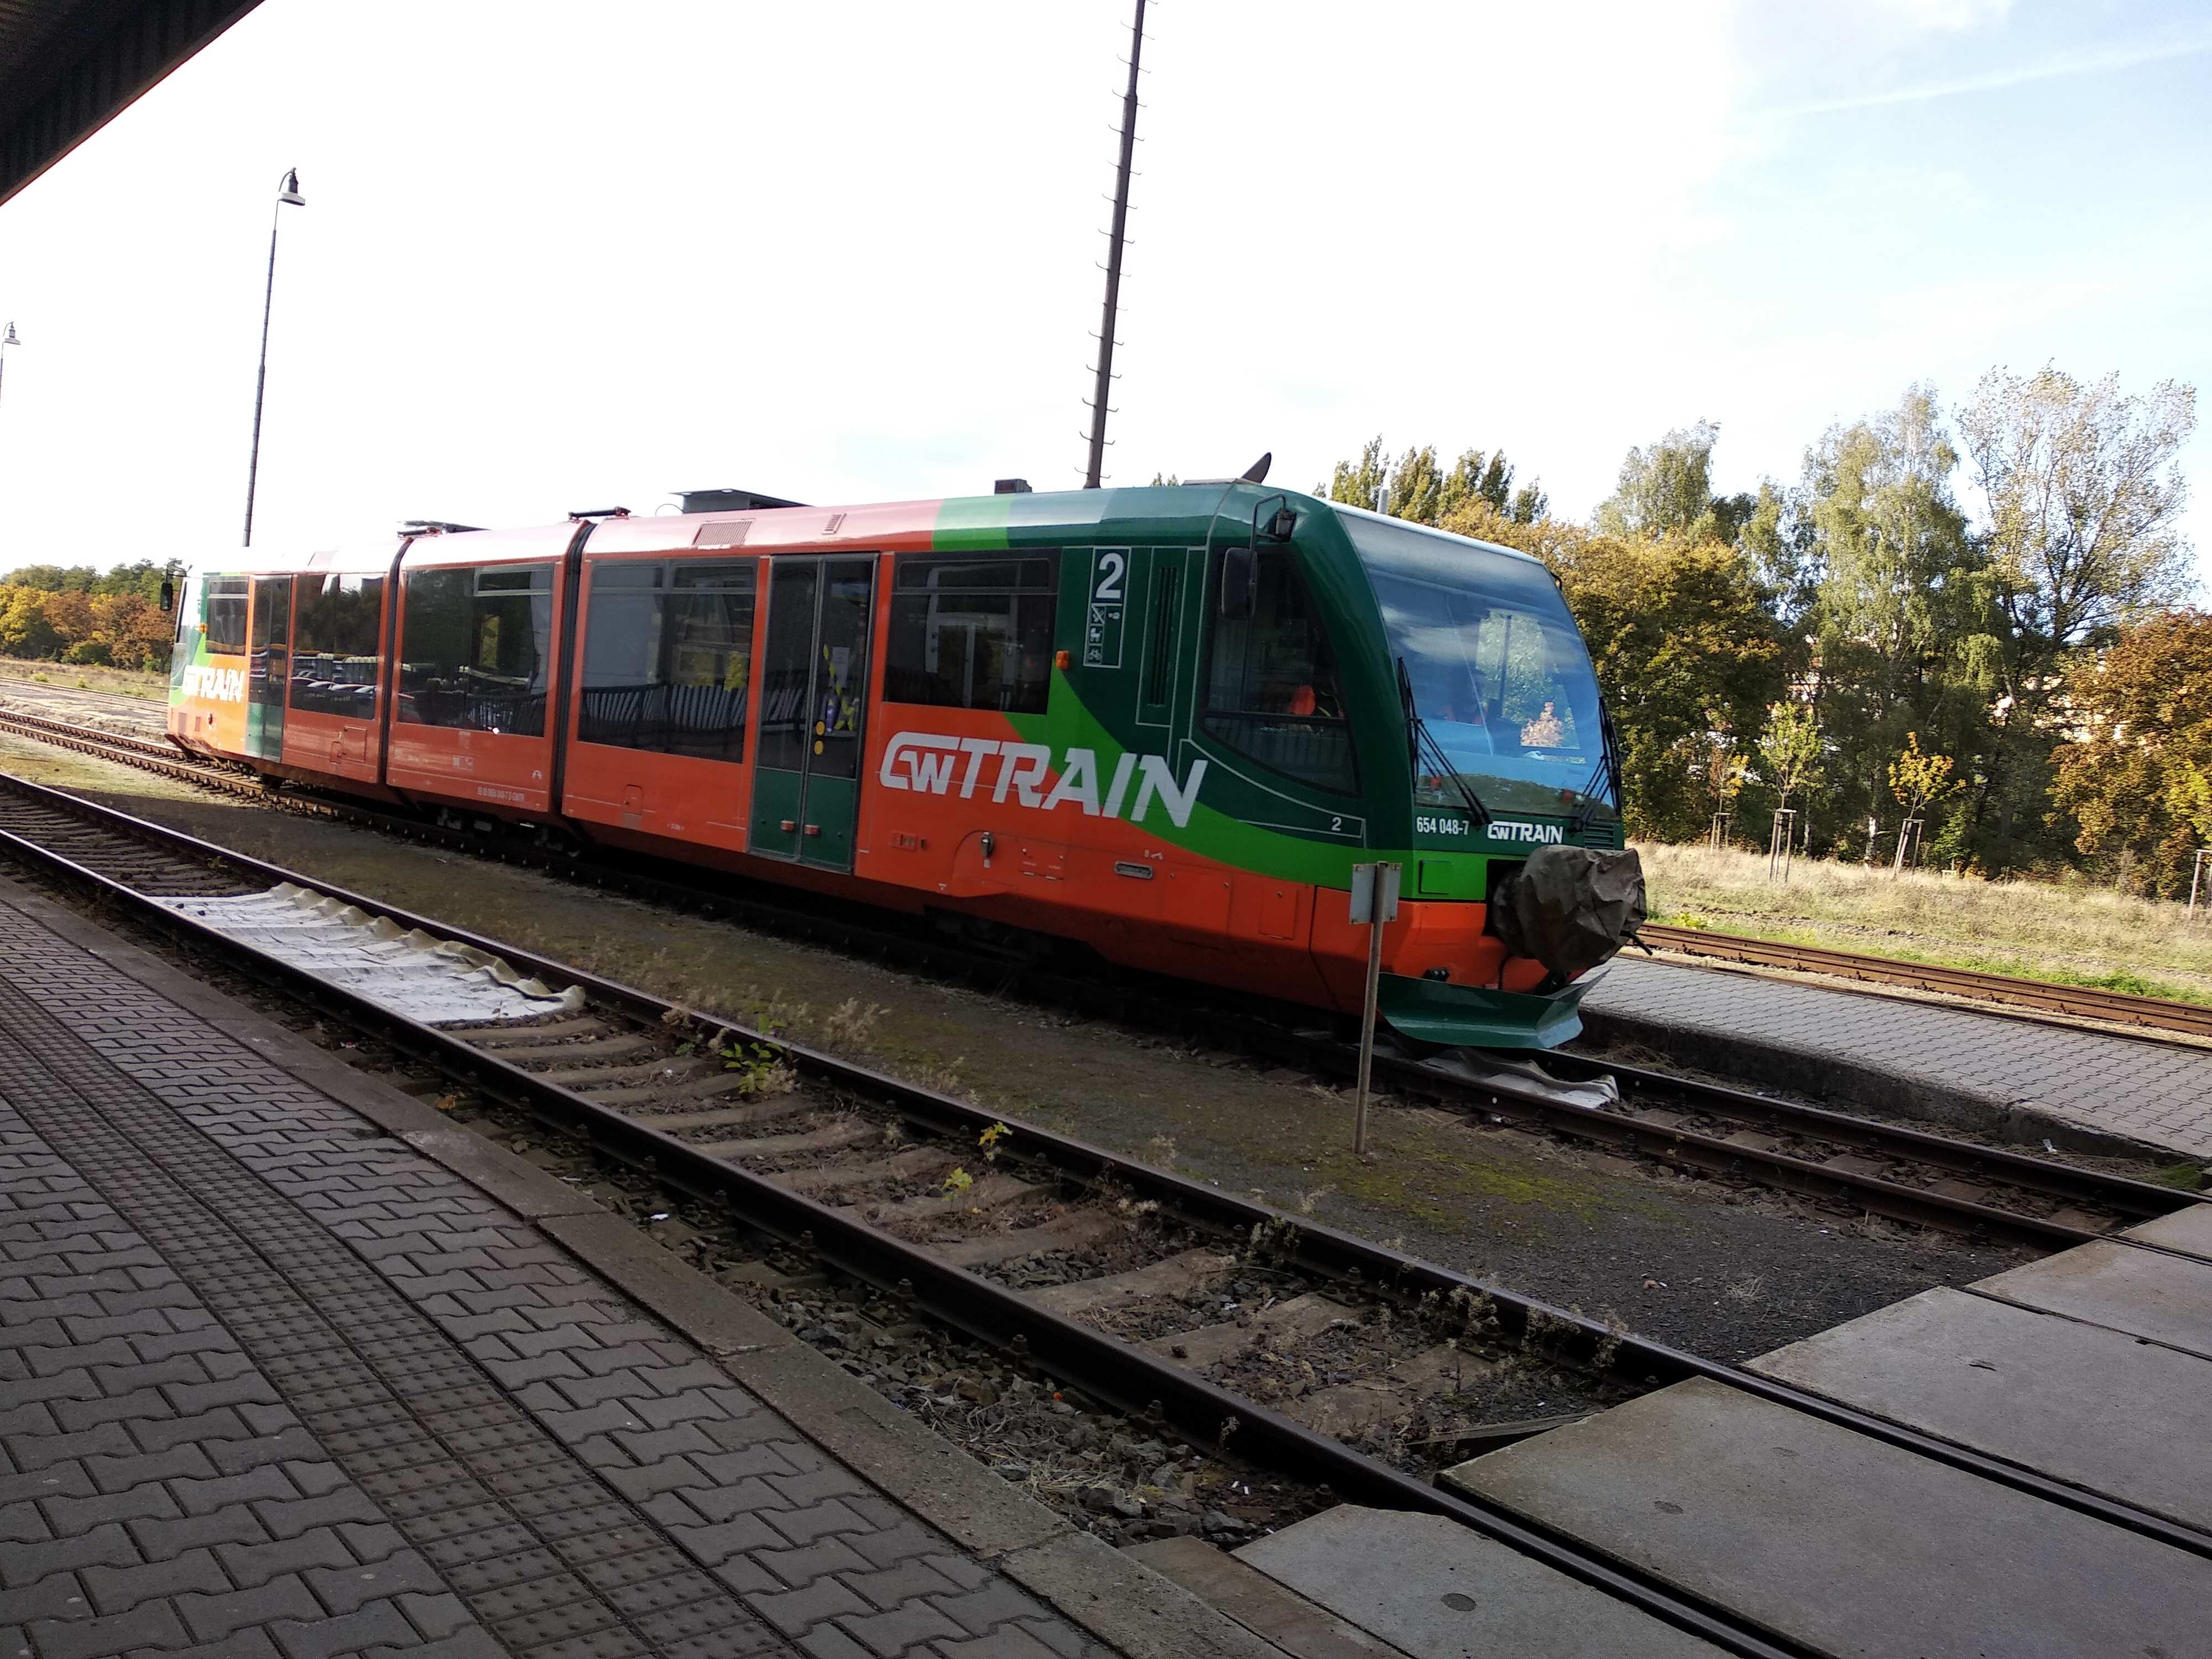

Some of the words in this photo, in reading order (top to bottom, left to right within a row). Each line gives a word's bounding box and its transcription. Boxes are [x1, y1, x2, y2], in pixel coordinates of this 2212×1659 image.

[1095, 552, 1124, 598] 2
[182, 665, 245, 702] TRAIN
[1331, 816, 1342, 831] 2
[1416, 816, 1437, 833] 654
[1439, 818, 1469, 836] 048-7
